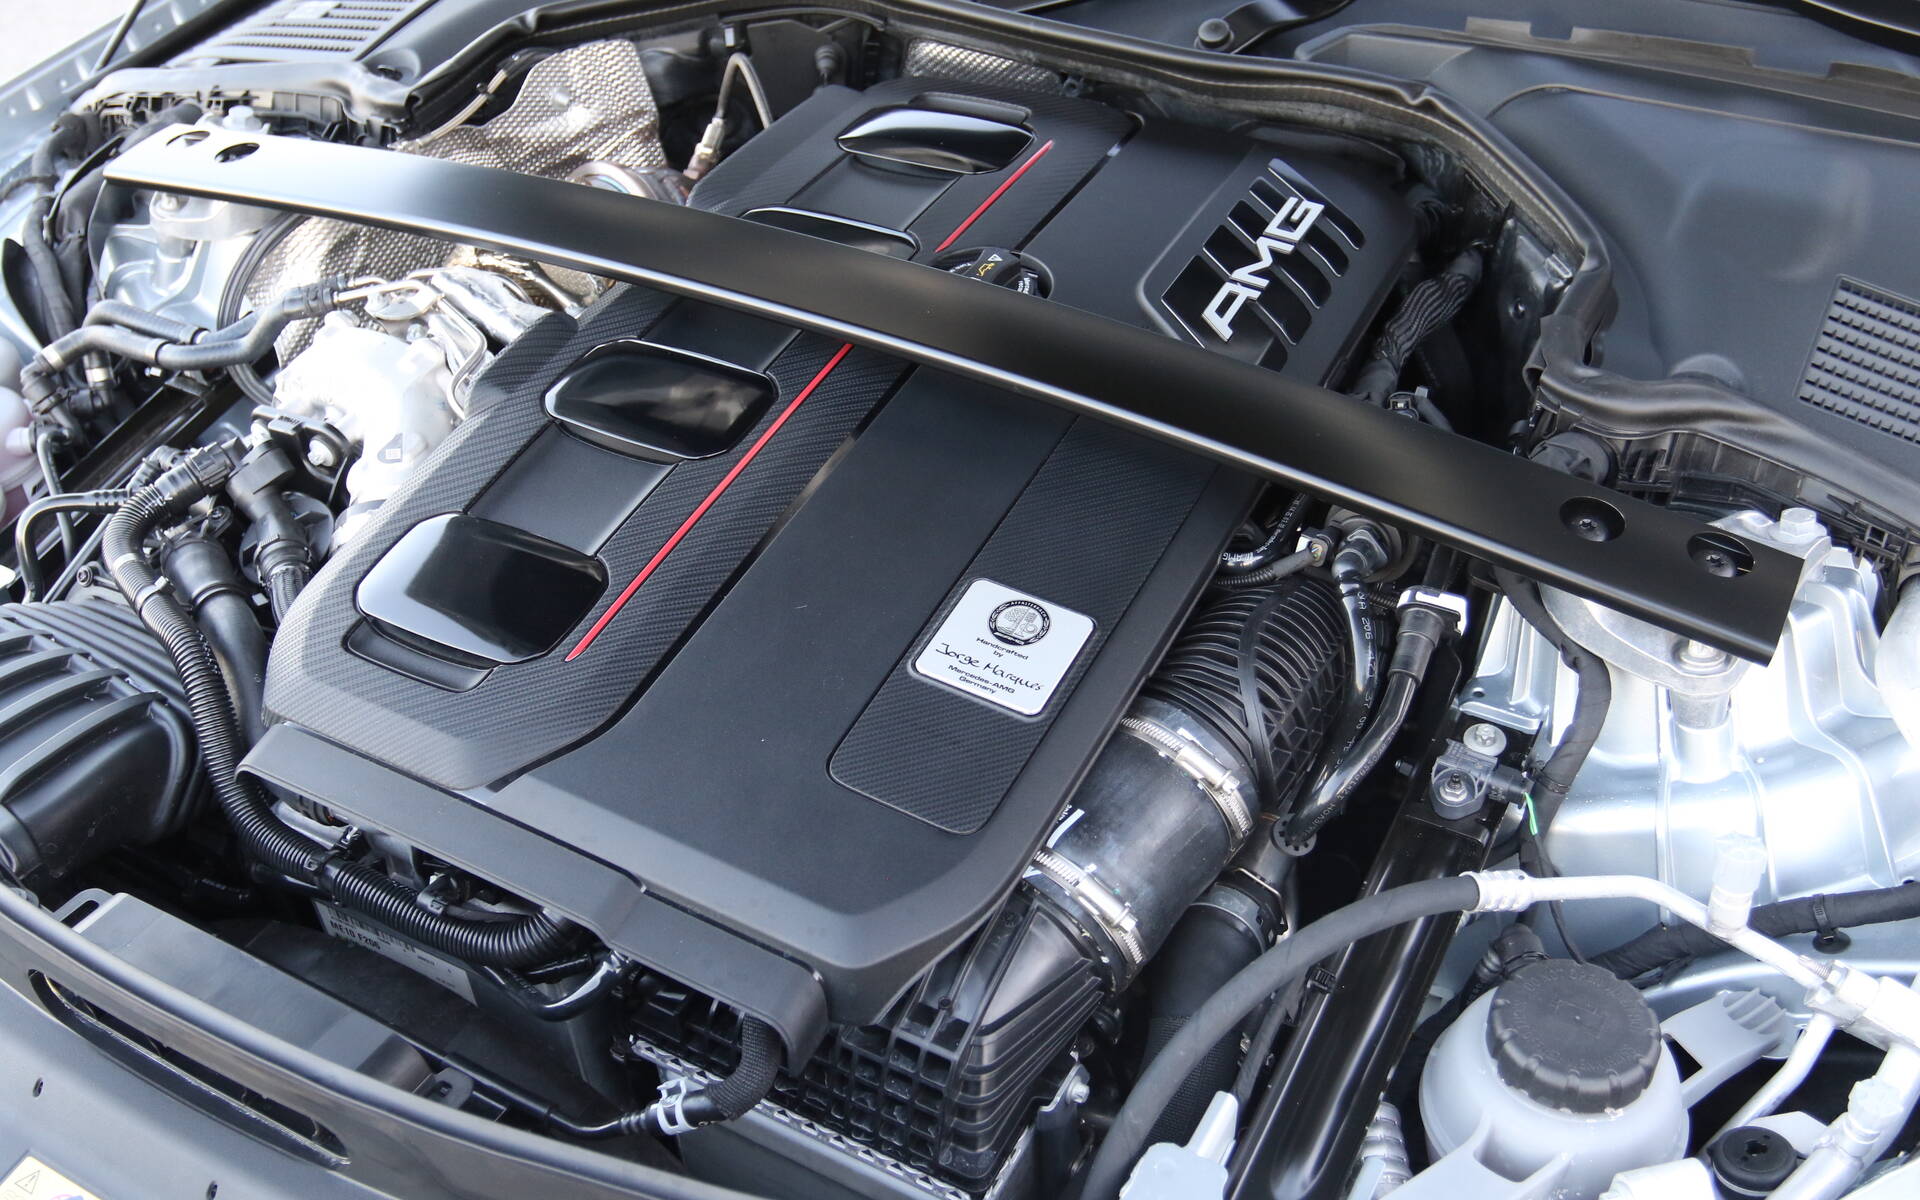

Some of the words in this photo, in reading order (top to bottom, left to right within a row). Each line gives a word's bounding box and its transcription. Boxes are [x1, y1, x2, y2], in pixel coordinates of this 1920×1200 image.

[1202, 197, 1325, 342] AMG
[1361, 617, 1373, 640] 206
[936, 642, 980, 668] Jorge
[976, 637, 1029, 661] Handcrafted
[993, 650, 1004, 658] by
[948, 664, 1016, 694] Mercedes-AMG
[959, 675, 997, 694] Germany
